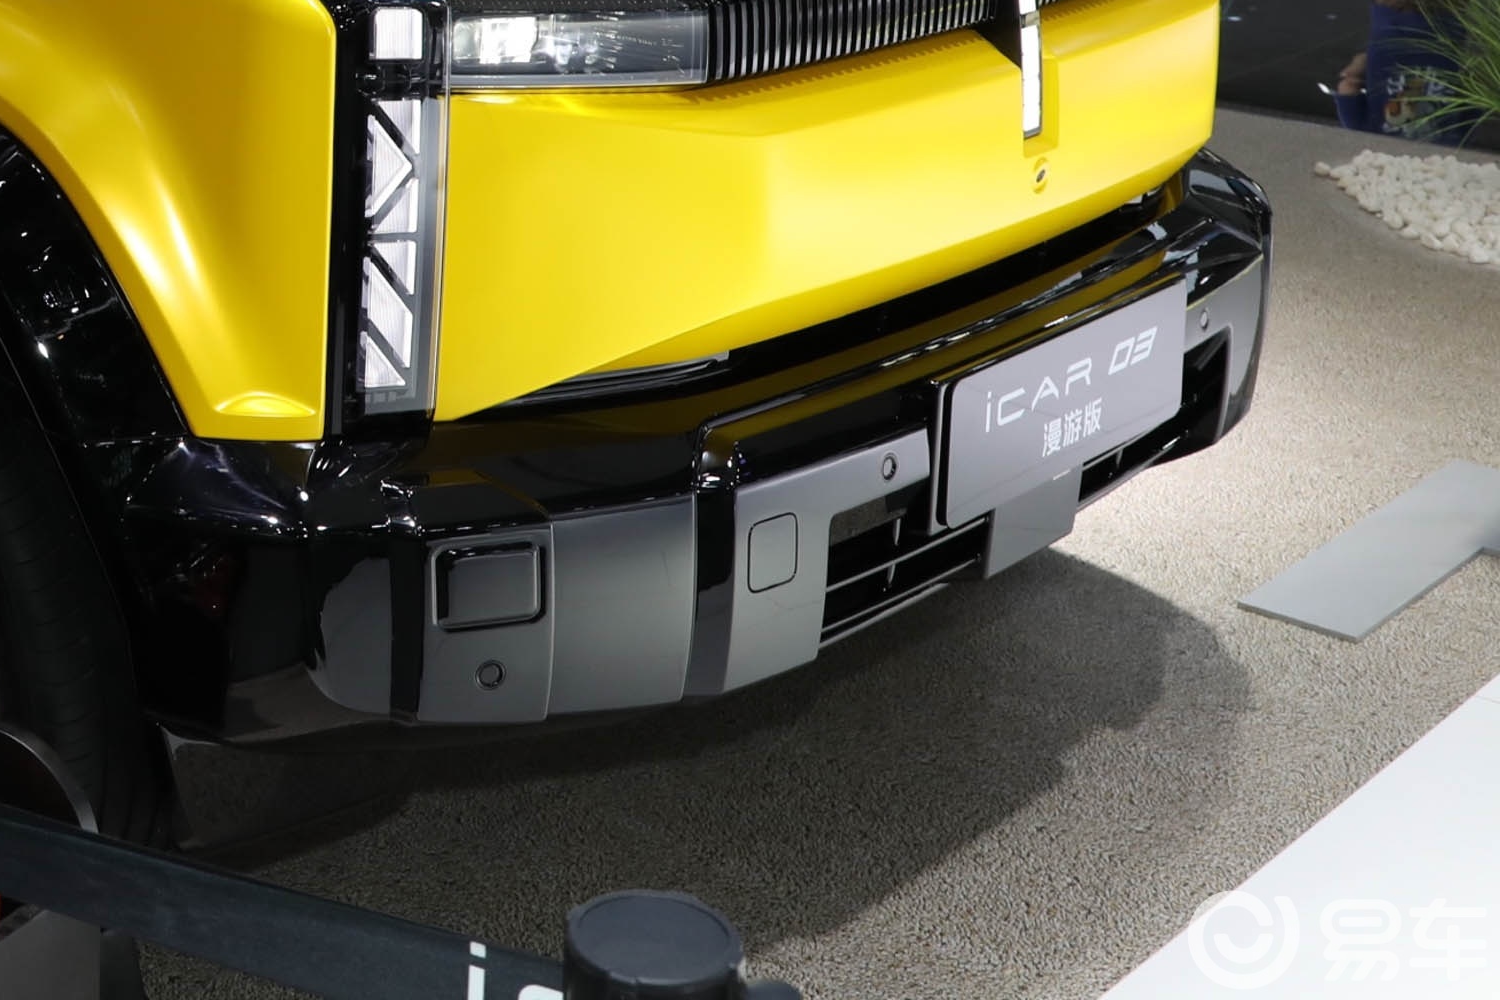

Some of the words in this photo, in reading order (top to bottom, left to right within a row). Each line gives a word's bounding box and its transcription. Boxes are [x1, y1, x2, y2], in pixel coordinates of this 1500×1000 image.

[985, 357, 1093, 433] iCAR
[1107, 325, 1158, 377] 03
[1041, 397, 1103, 458] 漫游版
